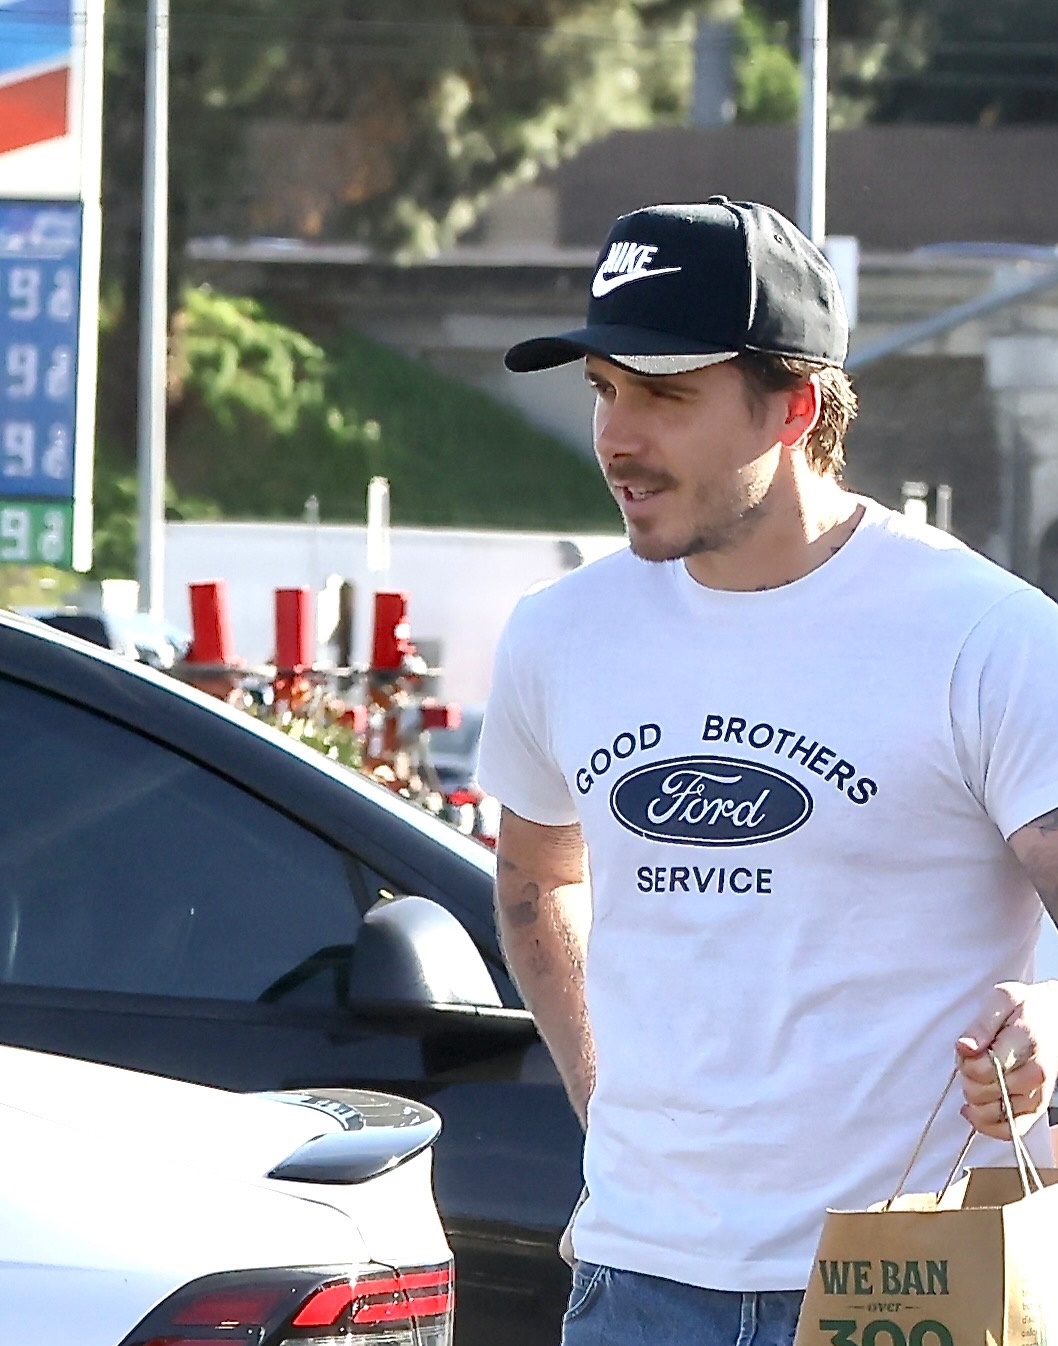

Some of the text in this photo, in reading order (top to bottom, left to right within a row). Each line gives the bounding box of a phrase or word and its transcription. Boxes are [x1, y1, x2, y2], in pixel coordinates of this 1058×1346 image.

[604, 242, 658, 273] NIKE
[576, 714, 878, 805] GOOD BROTHERS
[647, 769, 770, 828] Ford
[637, 866, 773, 893] SERVICE
[819, 1259, 949, 1296] WE BAN
[867, 1302, 902, 1313] over
